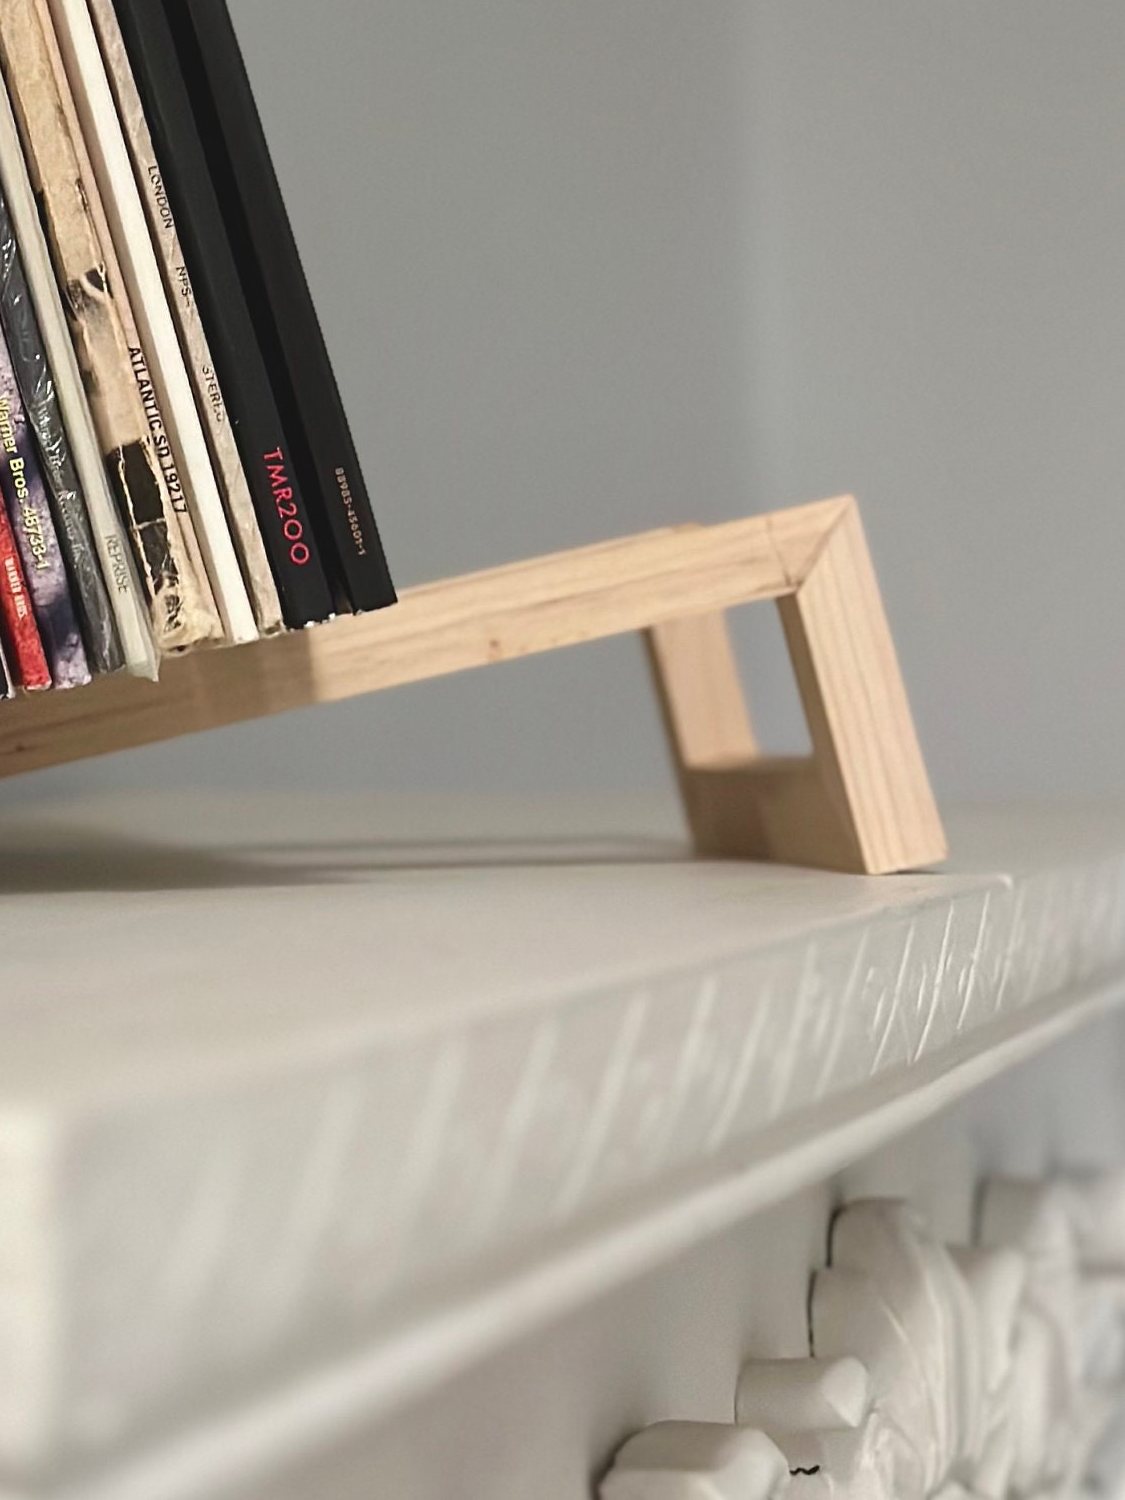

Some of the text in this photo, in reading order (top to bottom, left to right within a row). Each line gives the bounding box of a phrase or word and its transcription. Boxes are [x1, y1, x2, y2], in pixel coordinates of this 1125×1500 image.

[147, 164, 174, 230] LONDON
[201, 363, 226, 423] STEREO
[127, 344, 162, 431] ATLANTIC
[161, 463, 187, 516] 19217
[8, 456, 33, 504] Bros.
[261, 446, 311, 567] TMR200
[2, 556, 22, 594] WARNER
[104, 533, 131, 595] REPRISE
